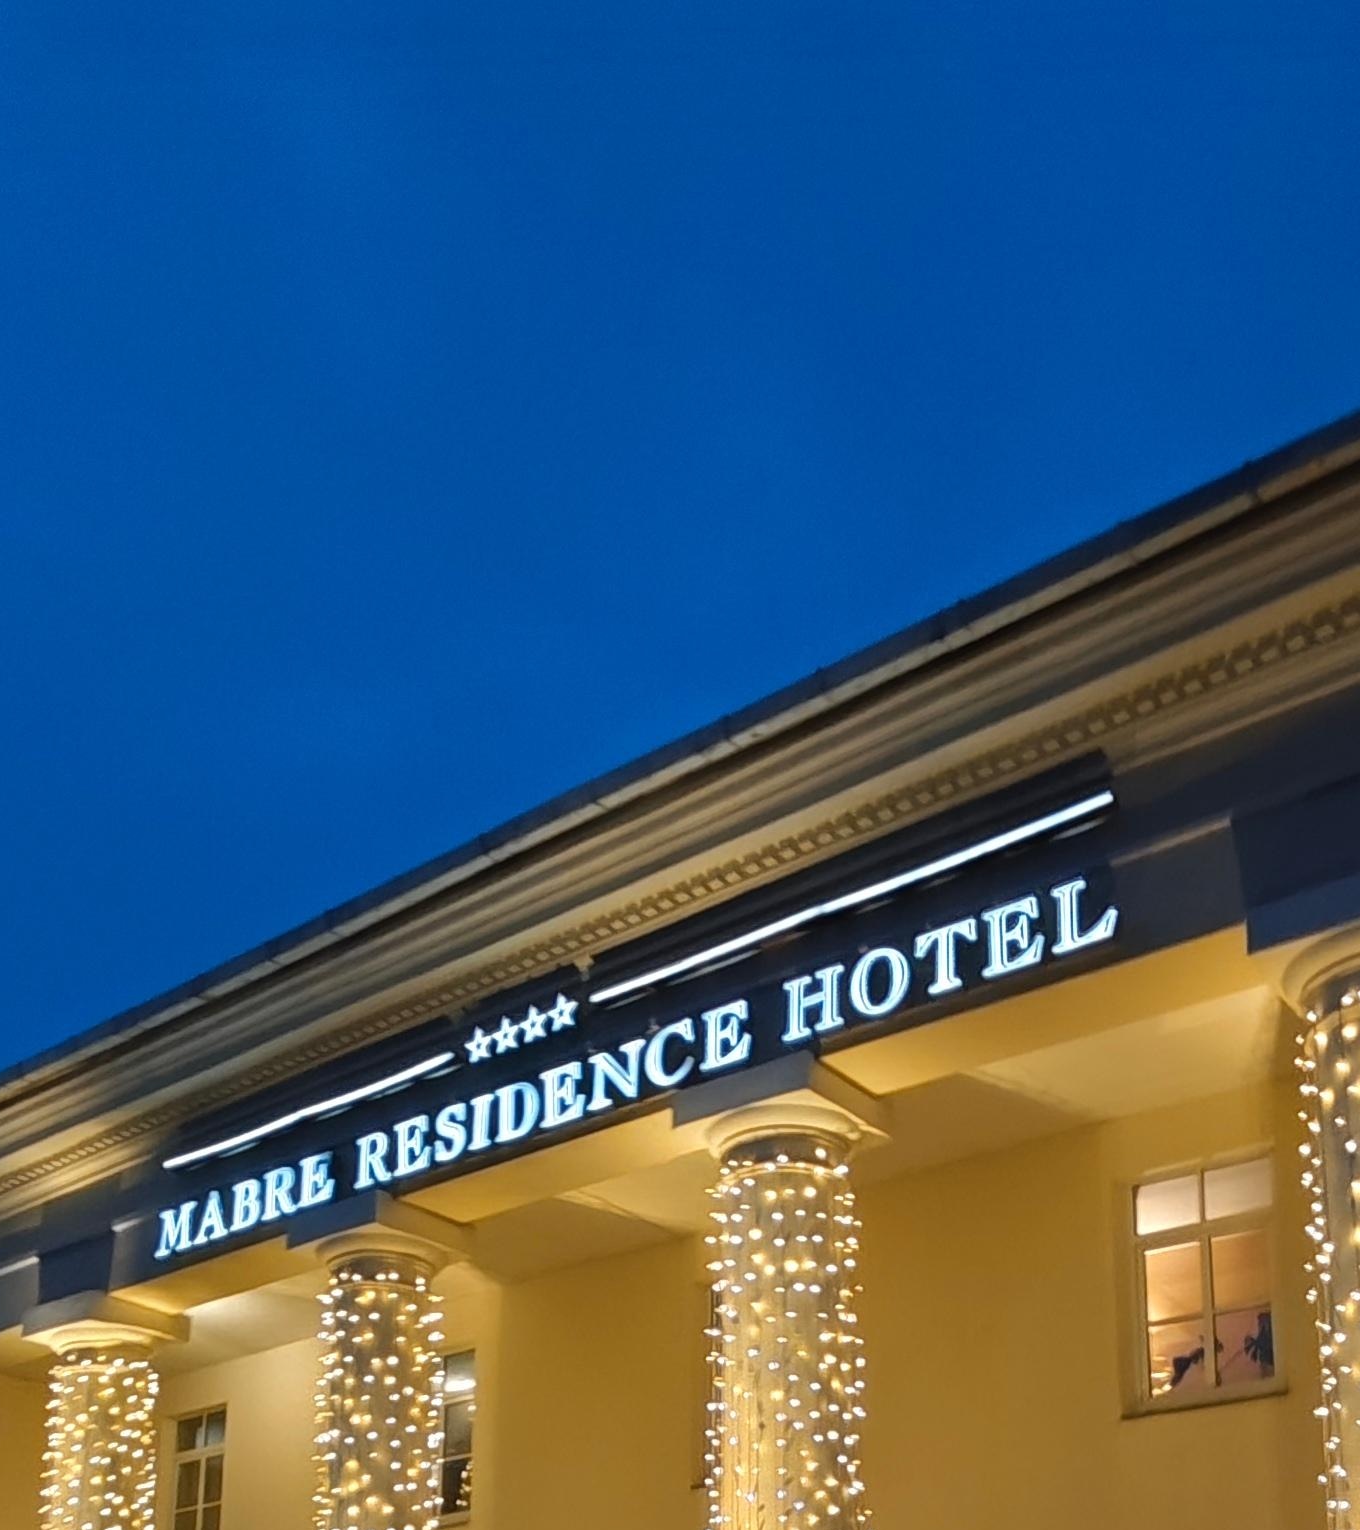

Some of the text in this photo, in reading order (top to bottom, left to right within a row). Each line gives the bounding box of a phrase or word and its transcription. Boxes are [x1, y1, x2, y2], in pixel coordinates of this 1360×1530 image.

[155, 879, 1120, 1259] MABRE RESIDENCE HOTEL
